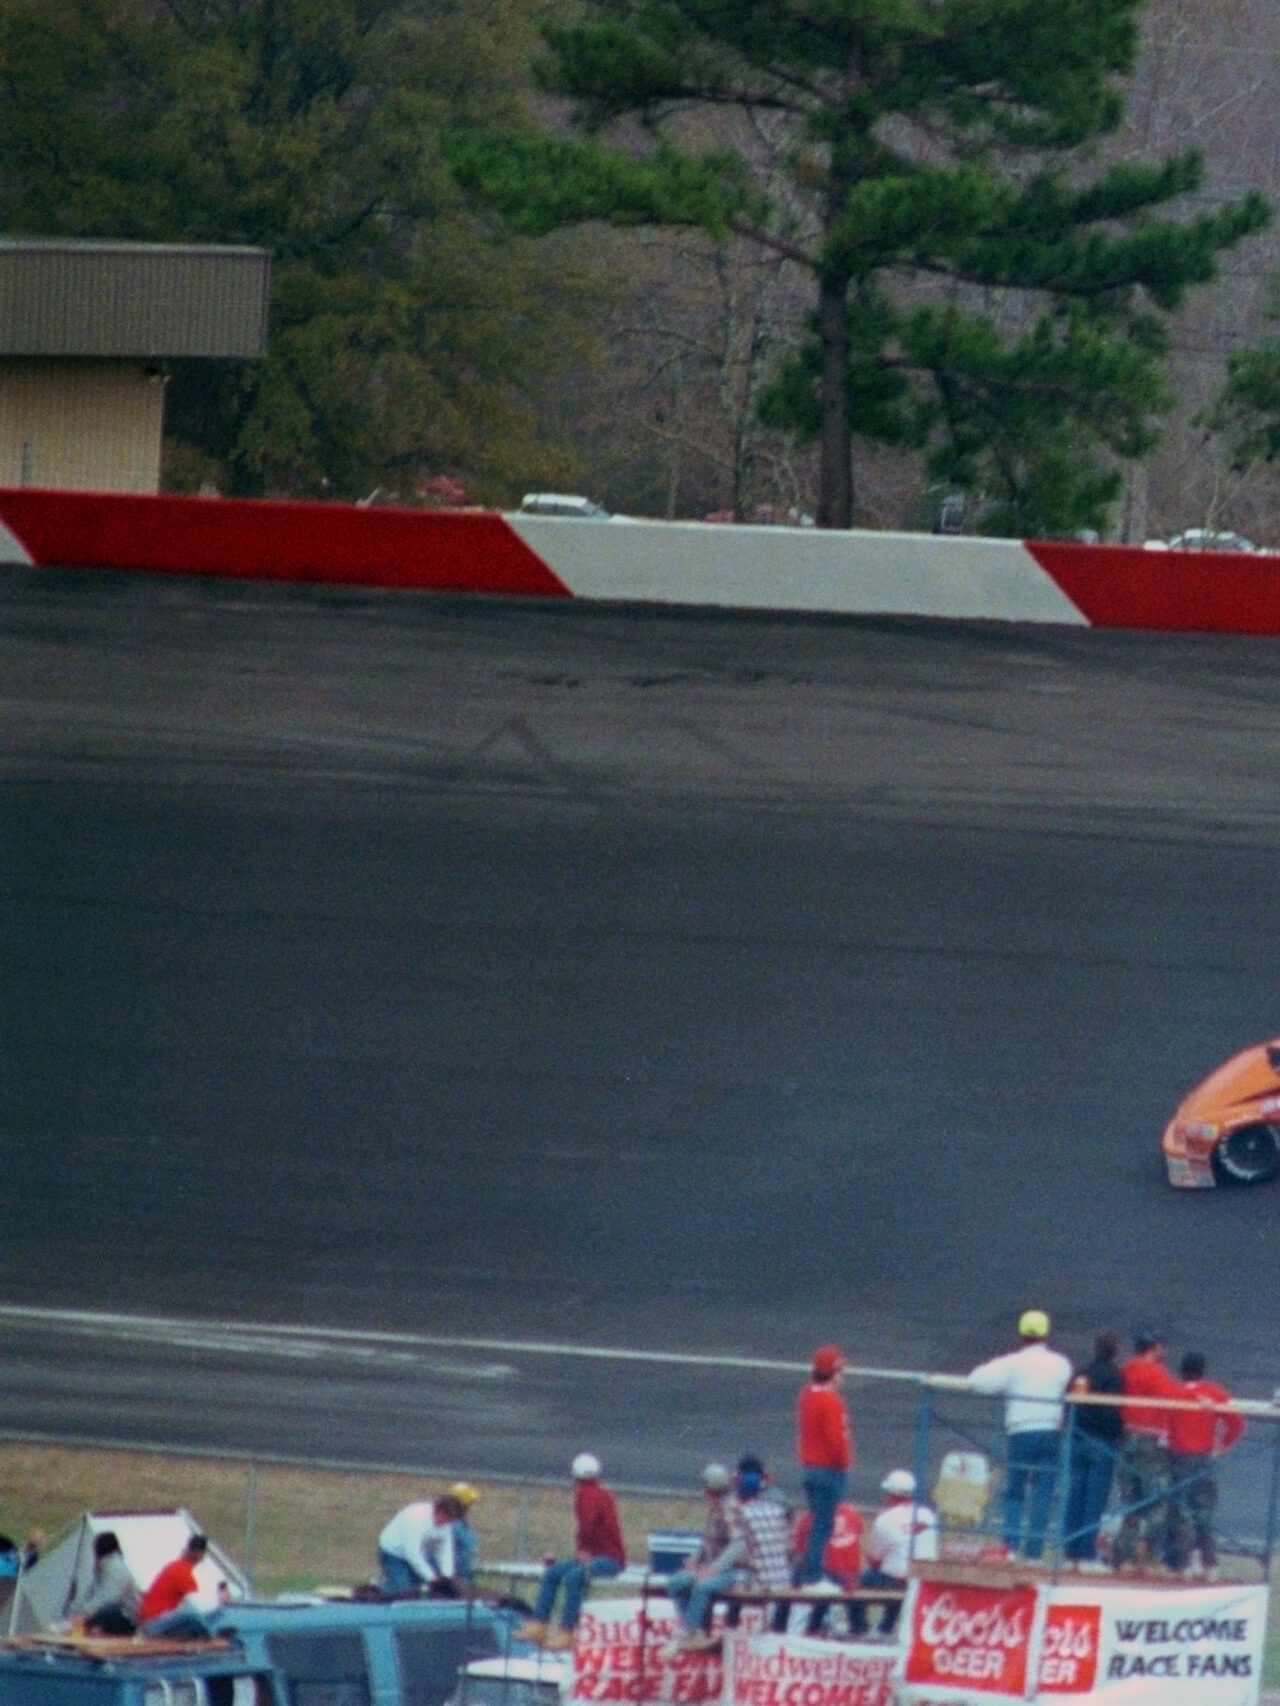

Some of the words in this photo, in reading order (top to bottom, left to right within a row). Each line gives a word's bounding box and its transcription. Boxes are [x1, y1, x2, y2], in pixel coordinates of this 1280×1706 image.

[920, 1591, 1027, 1649] Coors
[1114, 1618, 1248, 1643] WELCOME
[933, 1647, 1006, 1680] BEER
[1107, 1654, 1181, 1679] RACE
[1187, 1653, 1252, 1679] FANS
